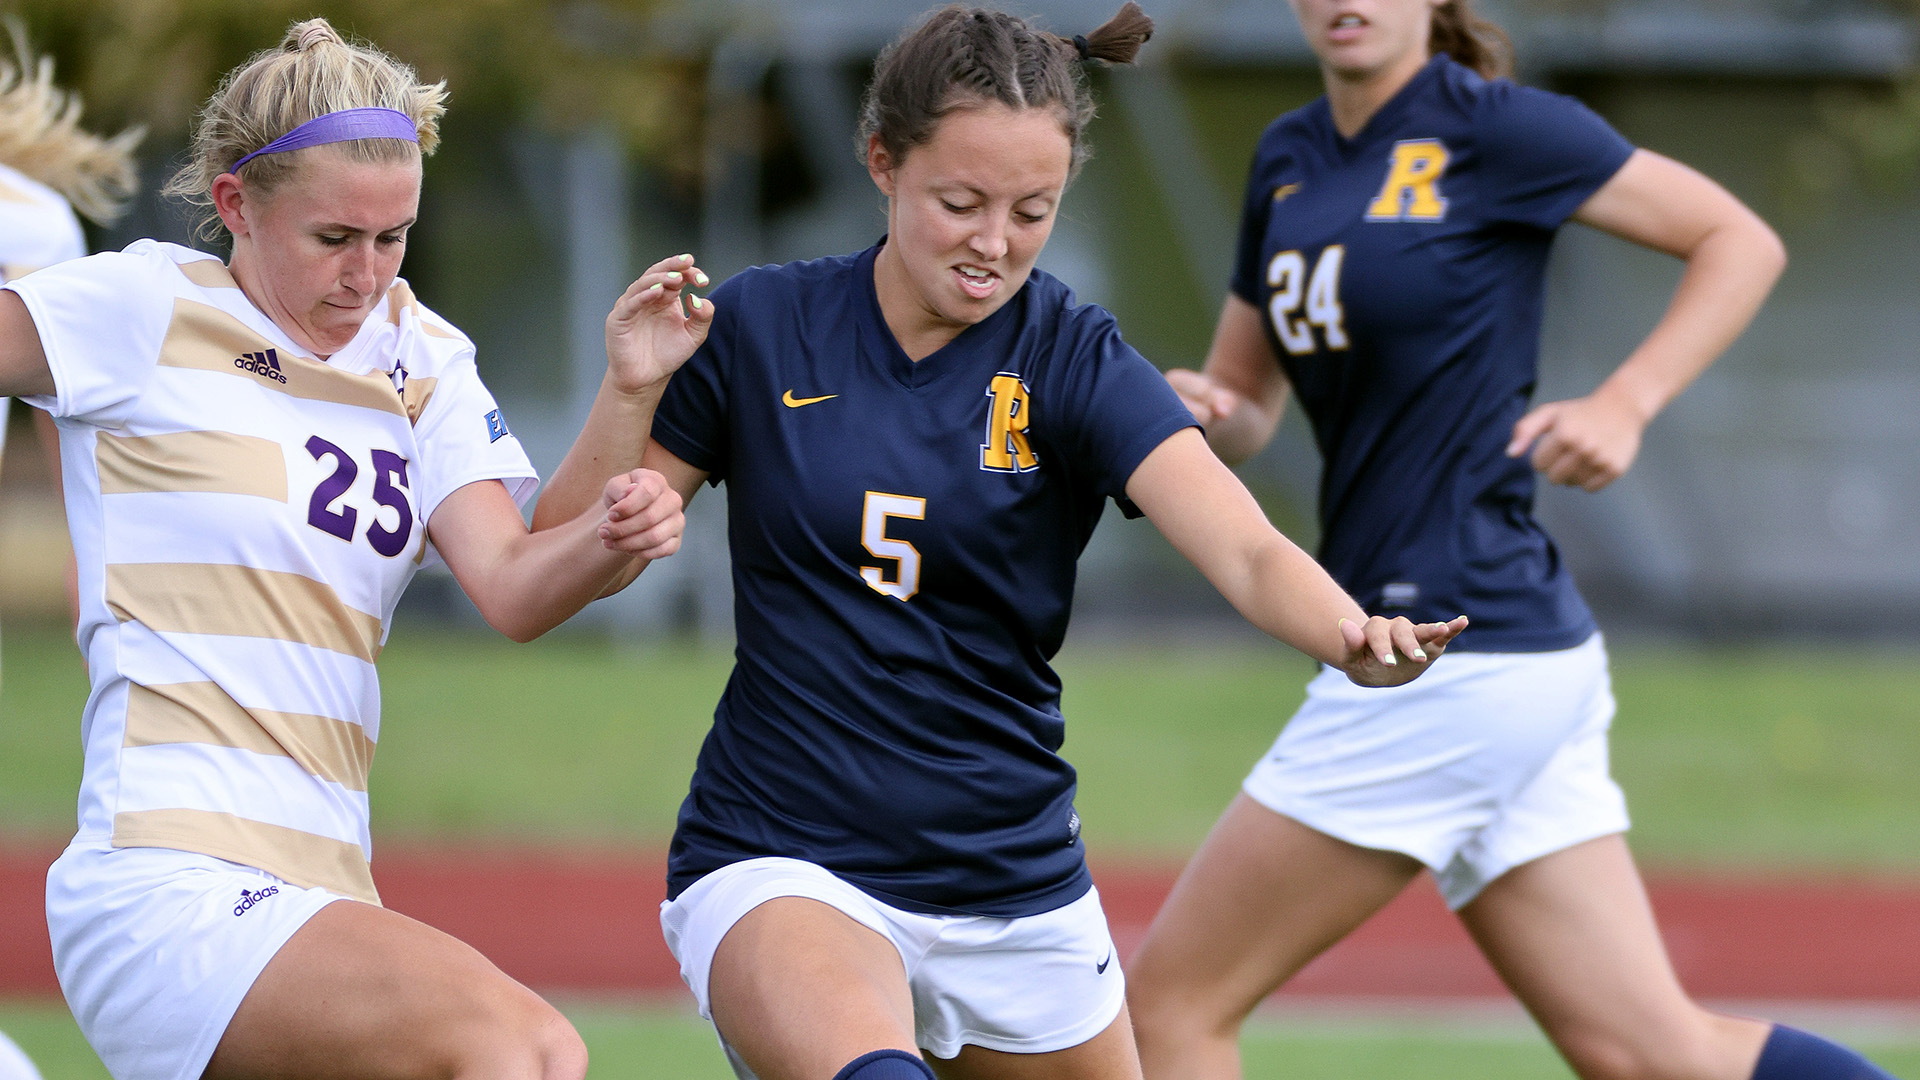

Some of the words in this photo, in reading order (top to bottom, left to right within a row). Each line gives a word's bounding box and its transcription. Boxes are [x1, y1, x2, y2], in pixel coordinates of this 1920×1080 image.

[1364, 137, 1450, 223] R
[1267, 244, 1349, 355] 24
[234, 358, 287, 384] adidas
[979, 370, 1041, 475] R
[304, 434, 413, 558] 25
[859, 490, 926, 602] 5
[233, 885, 279, 917] adidas
